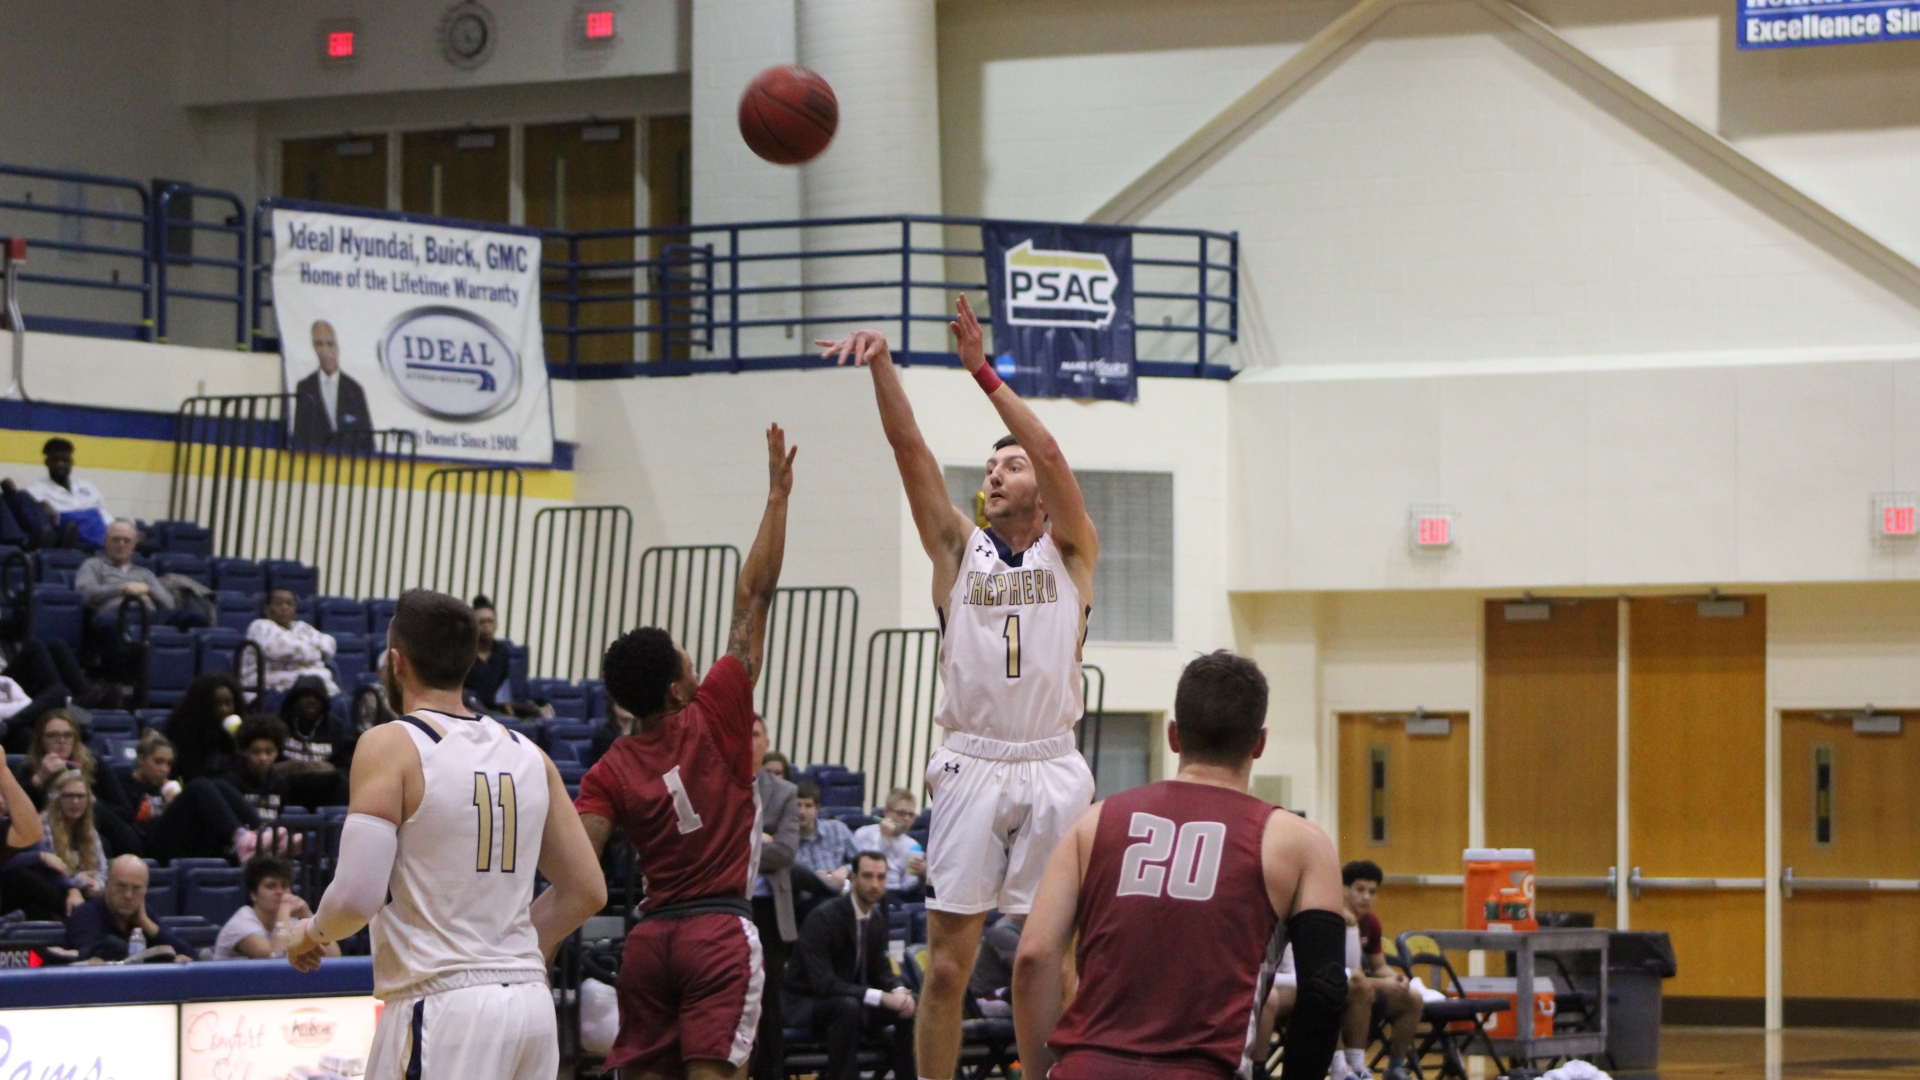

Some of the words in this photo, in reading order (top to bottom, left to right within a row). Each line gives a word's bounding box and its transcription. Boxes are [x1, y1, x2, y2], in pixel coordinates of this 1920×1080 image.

[1746, 13, 1882, 43] Excellence
[288, 221, 335, 253] Ideal
[340, 226, 420, 267] Hyundai,
[425, 235, 481, 273] Buick,
[486, 243, 528, 273] GMC
[300, 262, 342, 287] Home
[347, 267, 360, 288] of
[365, 269, 388, 291] the
[392, 271, 450, 298] Lifetime
[454, 277, 519, 308] Warranty
[1010, 270, 1109, 305] PSAC
[403, 335, 495, 366] IDEAL
[460, 432, 488, 449] Since
[963, 569, 1058, 606] SHEPHERD
[1002, 614, 1021, 678] 1
[473, 771, 517, 873] 11
[662, 765, 703, 835] 1
[1116, 812, 1227, 901] 20
